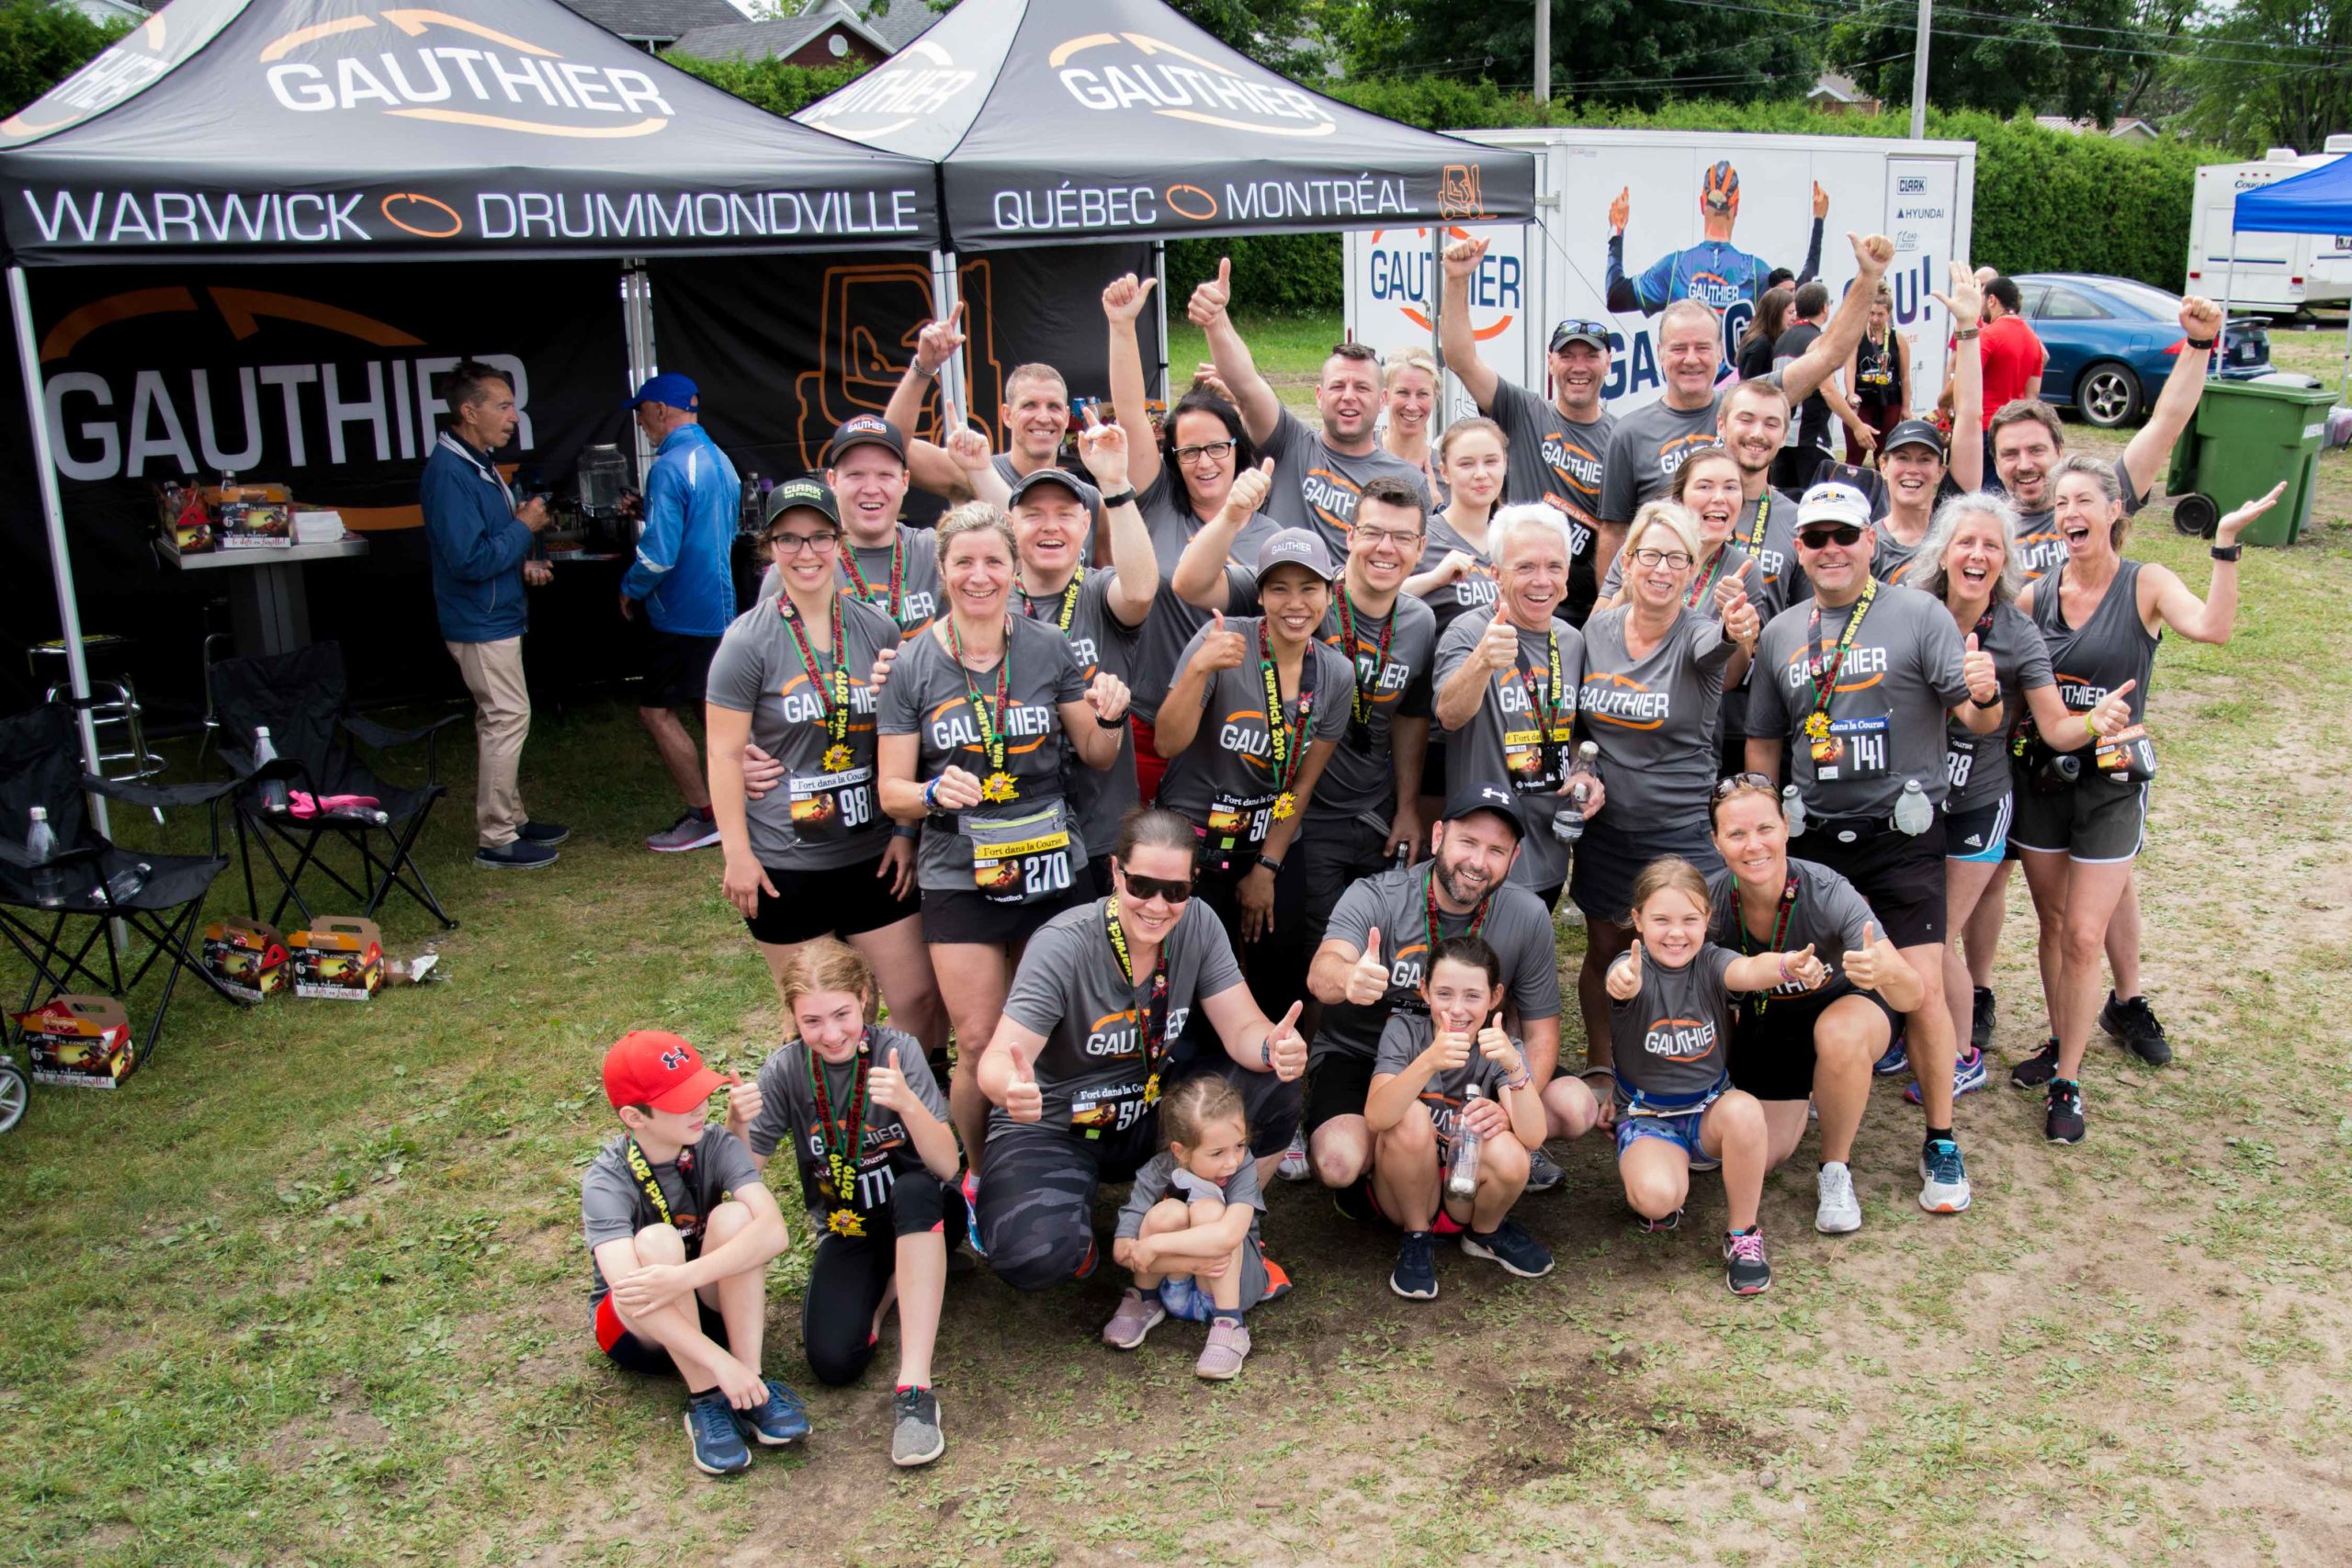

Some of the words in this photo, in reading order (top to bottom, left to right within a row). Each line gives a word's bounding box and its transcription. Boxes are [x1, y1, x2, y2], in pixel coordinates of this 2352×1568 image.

[266, 46, 675, 116] GAUTHIER
[1057, 60, 1336, 123] GAUTHIER
[993, 180, 1158, 231] QUÉBEC
[1226, 172, 1419, 221] MONTRÉAL
[1899, 179, 1925, 193] CLARK
[23, 189, 372, 242] WARWICK
[478, 189, 919, 239] DRUMMONDVILLE
[1905, 208, 1944, 220] HYUNDAI
[1688, 282, 1739, 303] GAUTHIER
[847, 420, 887, 433] GAUTHIER
[1542, 441, 1603, 484] GAUTHIE
[784, 484, 821, 496] CLARK
[1303, 477, 1357, 515] GAUTH
[1272, 541, 1312, 555] GAUTHIER
[835, 671, 849, 705] 2019
[1264, 669, 1283, 726] warwick
[1578, 685, 1669, 718] GAUTHIER
[1858, 720, 1884, 729] Course
[1272, 728, 1286, 761] 2019
[1850, 735, 1885, 771] 141
[797, 780, 816, 790] Fort
[817, 777, 836, 788] dans
[1223, 794, 1242, 806] Fort
[1243, 797, 1260, 807] dans
[983, 847, 1003, 857] Fort
[1004, 845, 1025, 855] dans
[1026, 842, 1035, 852] la
[1035, 838, 1063, 850] Course
[1024, 852, 1071, 894] 270
[1080, 1089, 1101, 1100] Fort
[1102, 1087, 1123, 1098] dans
[841, 1165, 856, 1201] 2019
